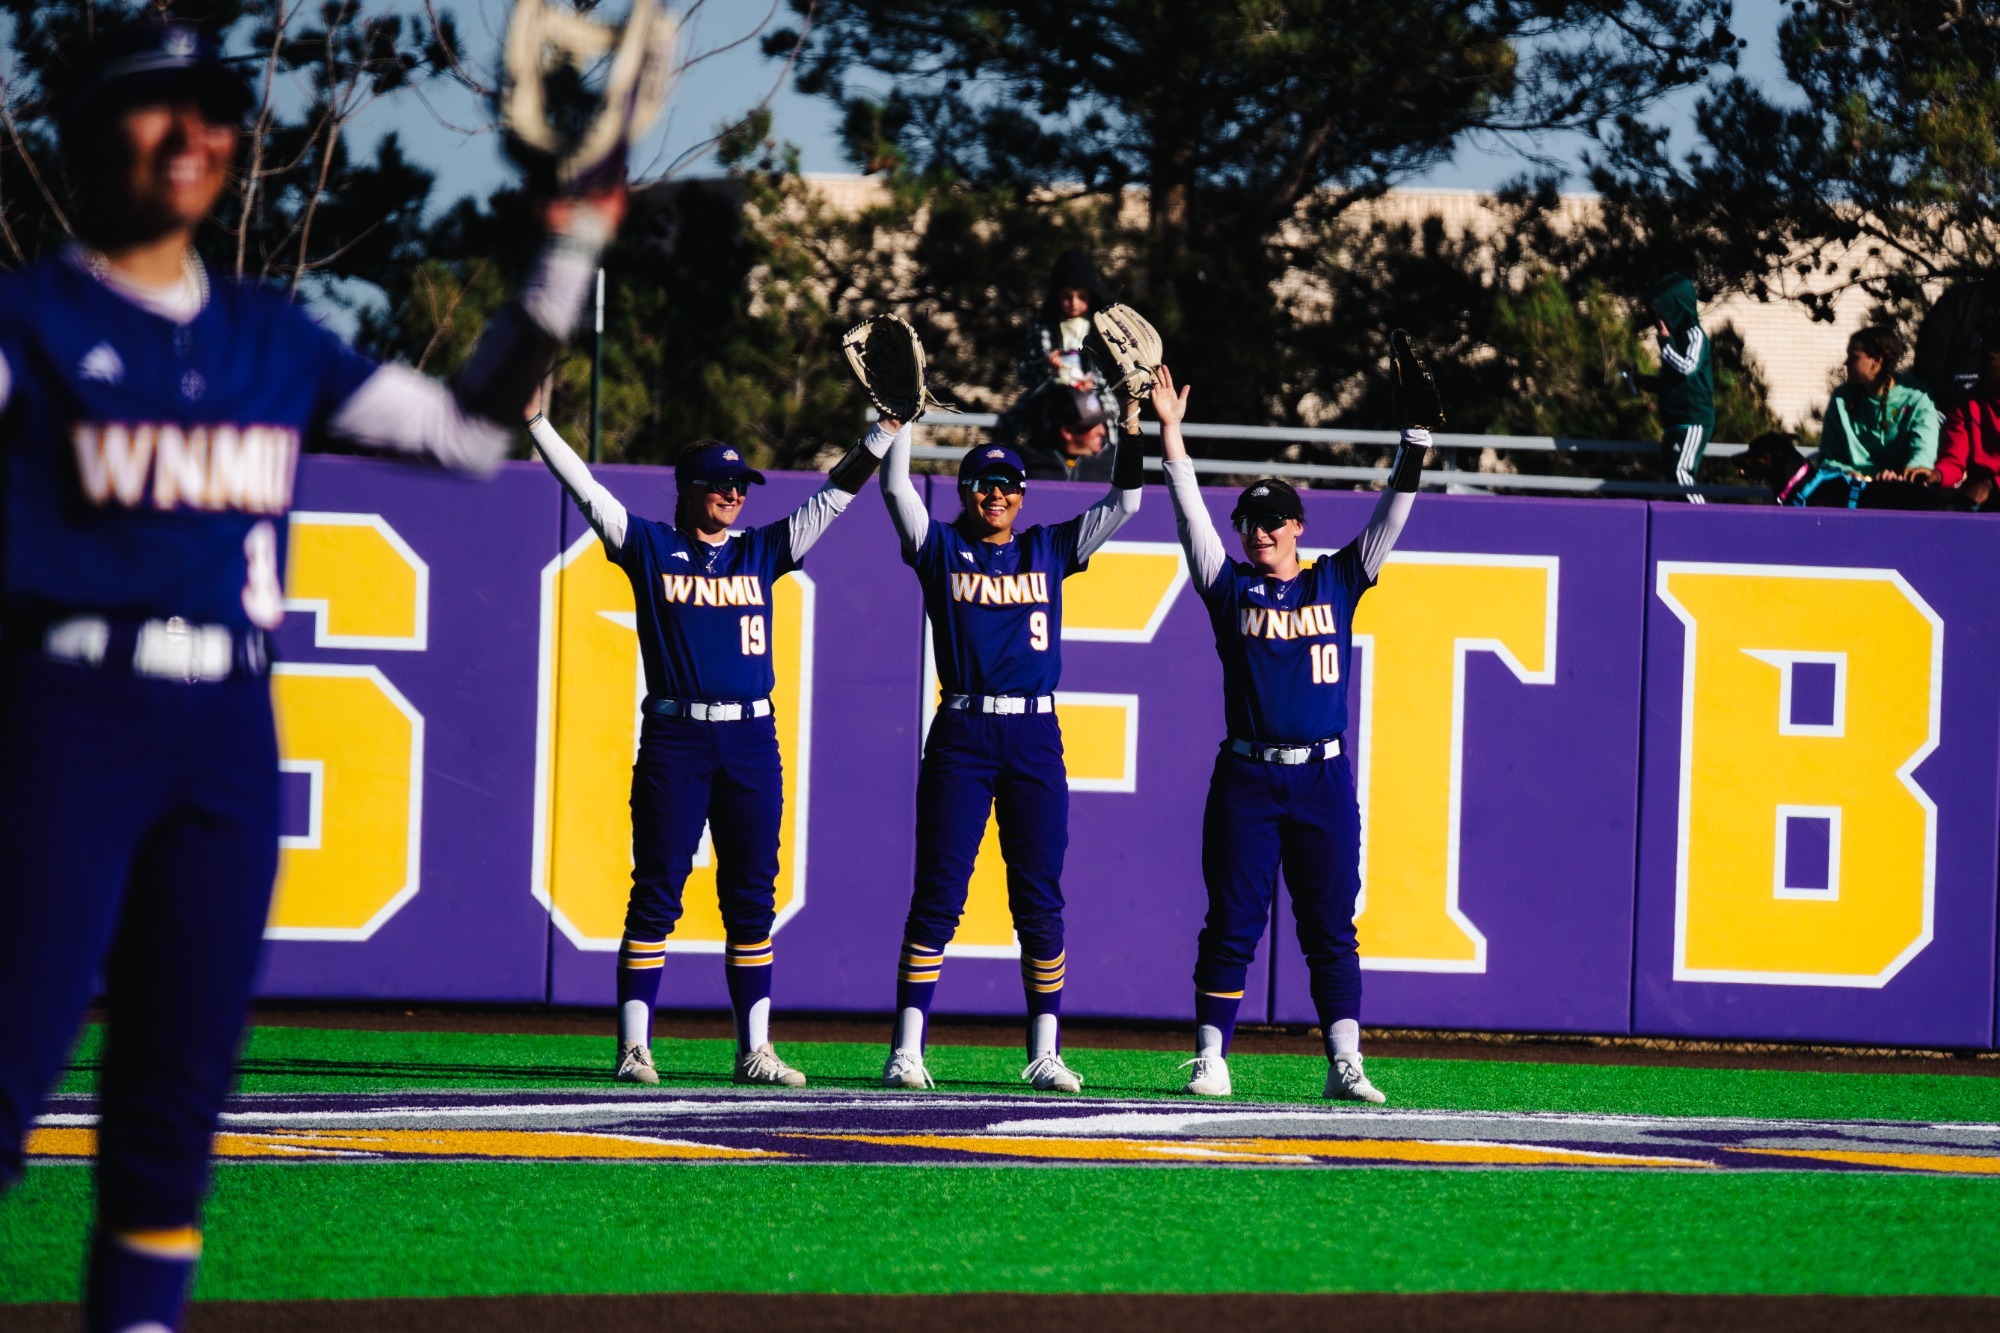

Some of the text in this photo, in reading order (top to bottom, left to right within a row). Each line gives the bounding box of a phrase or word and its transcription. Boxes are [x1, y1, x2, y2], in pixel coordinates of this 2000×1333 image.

[662, 573, 765, 607] WNMU
[951, 572, 1049, 604] WNMU
[740, 615, 766, 656] 19
[1029, 611, 1049, 651] 9
[1240, 604, 1336, 640] WNMU
[1310, 643, 1340, 684] 10
